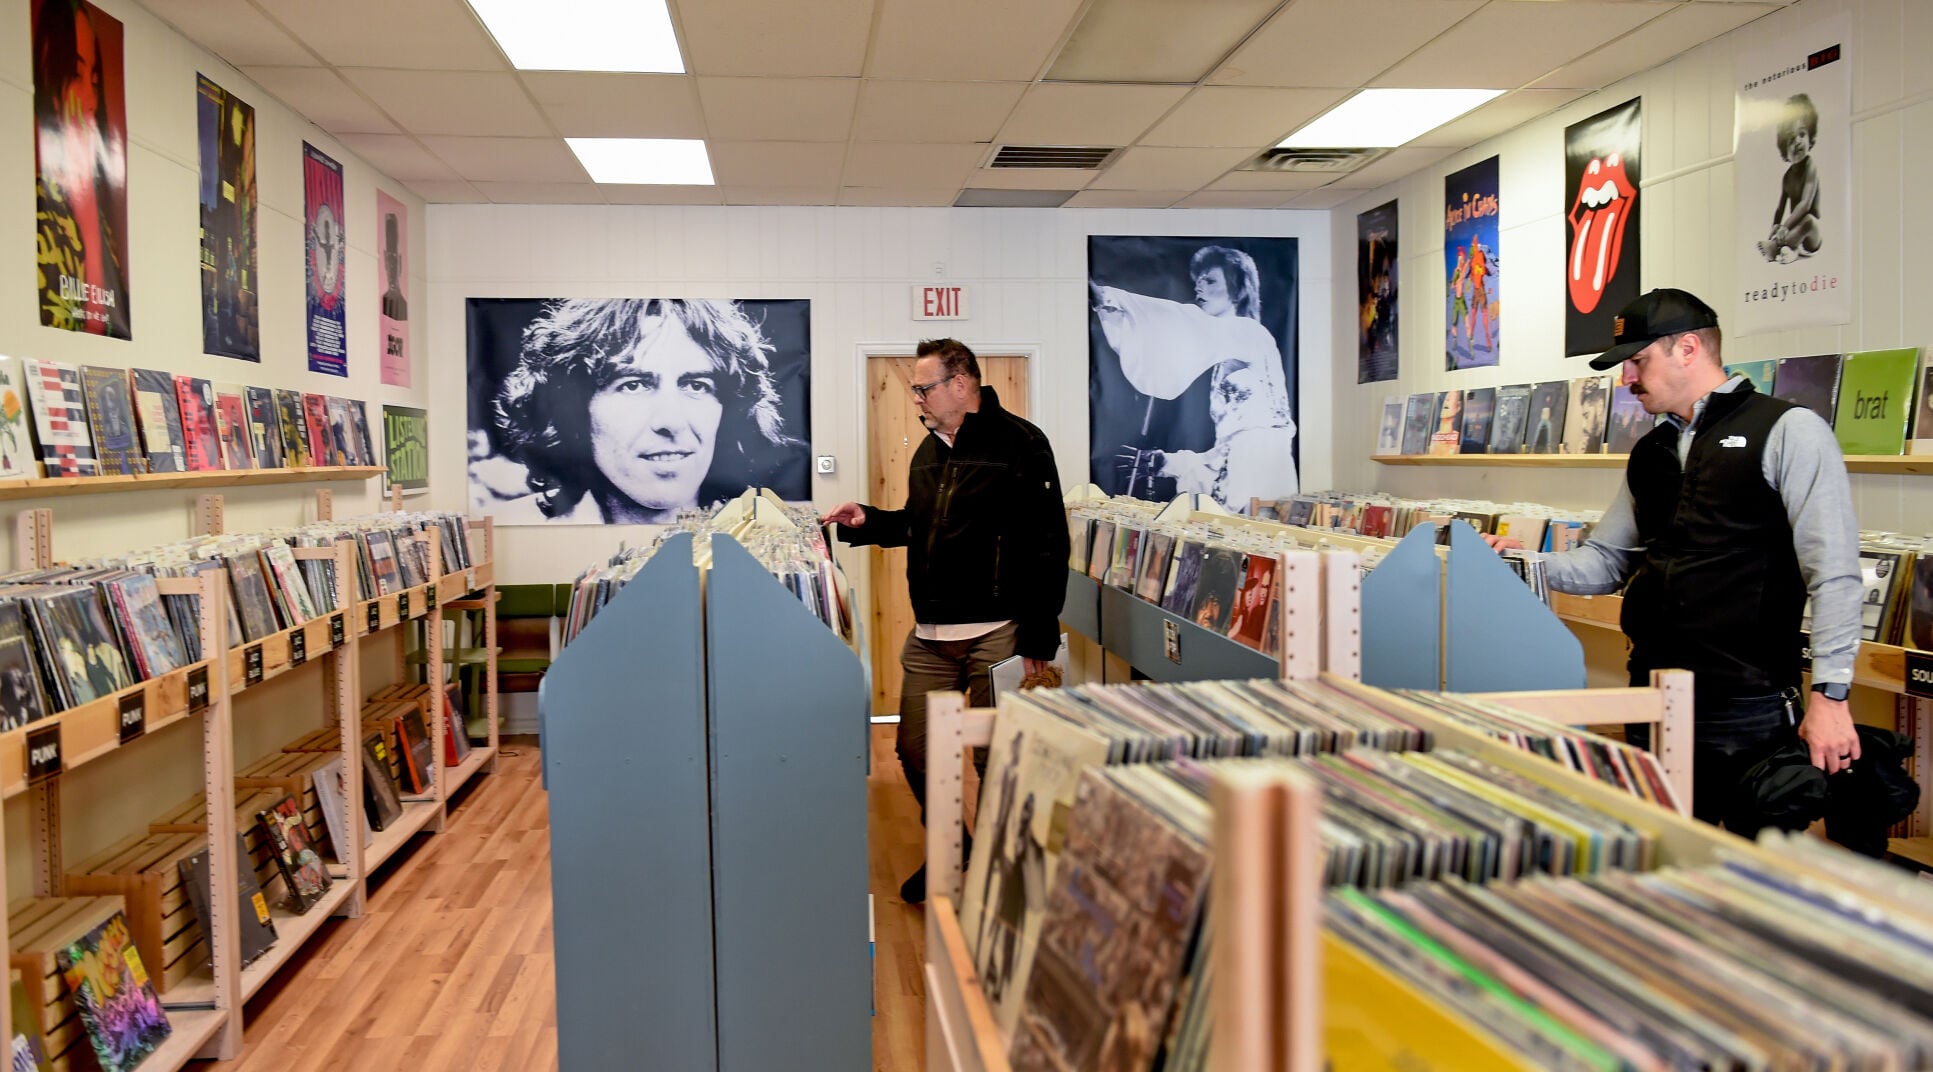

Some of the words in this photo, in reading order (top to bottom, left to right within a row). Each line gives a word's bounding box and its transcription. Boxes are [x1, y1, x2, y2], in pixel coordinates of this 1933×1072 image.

[1744, 81, 1758, 91] the
[1762, 62, 1806, 85] notorious
[924, 287, 961, 316] EXIT
[1854, 390, 1889, 420] brat
[388, 414, 426, 449] LISTENING
[390, 441, 427, 481] STATION
[189, 682, 207, 699] PUNK
[1911, 668, 1933, 684] SOU
[122, 707, 143, 728] PUNK
[31, 743, 58, 766] PUNK
